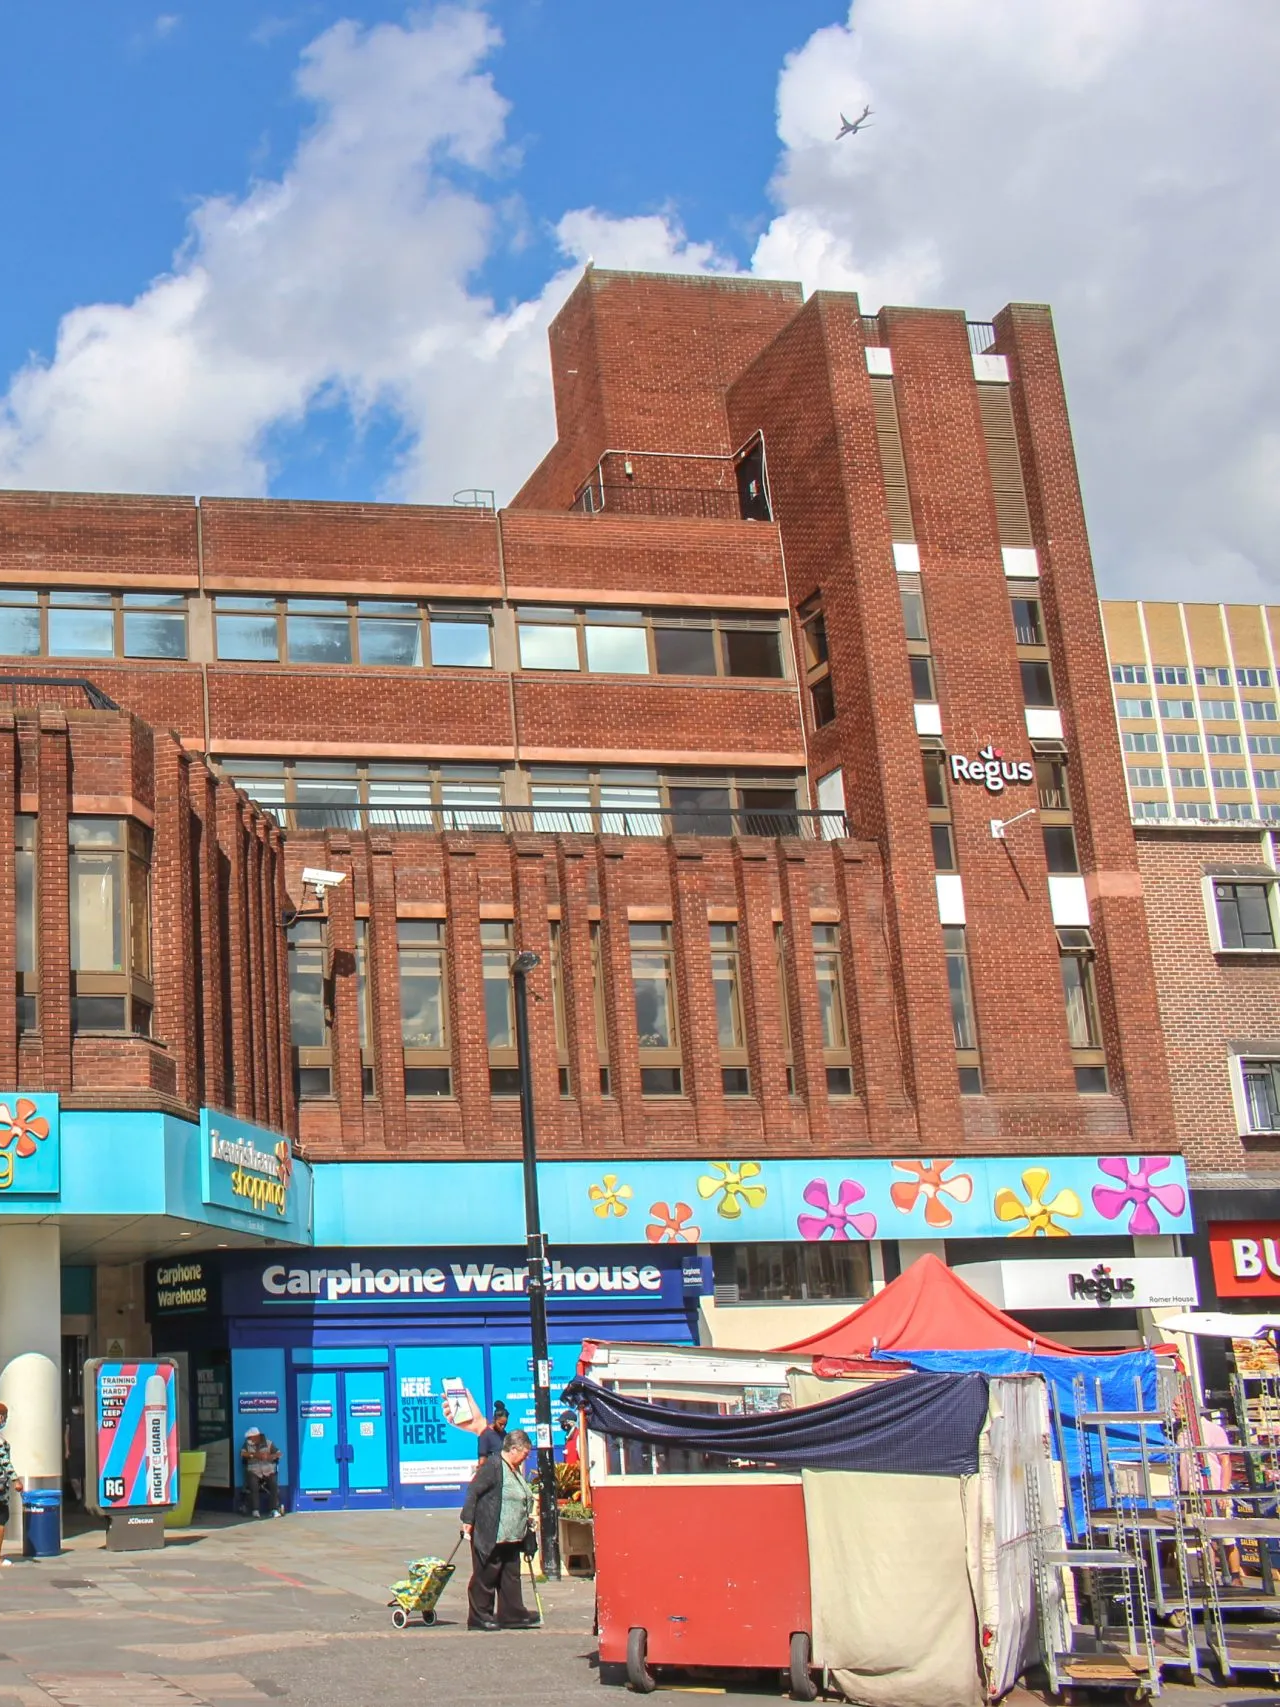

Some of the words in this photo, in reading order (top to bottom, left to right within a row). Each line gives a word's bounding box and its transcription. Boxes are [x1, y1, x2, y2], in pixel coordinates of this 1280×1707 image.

[950, 755, 1033, 790] Regus
[210, 1129, 279, 1177] Lewisham
[231, 1163, 286, 1216] shopping
[157, 1263, 202, 1287] Carphone
[262, 1262, 446, 1300] Carphone
[158, 1287, 207, 1307] Warehouse
[1069, 1273, 1135, 1301] Regus
[102, 1377, 136, 1385] TRAINING
[102, 1387, 126, 1395] HARD?
[402, 1397, 416, 1405] BUT
[103, 1409, 121, 1417] KEEP
[402, 1406, 441, 1423] STILL
[103, 1420, 116, 1428] UP.
[402, 1424, 447, 1445] HERE
[152, 1418, 161, 1455] GUARD
[105, 1479, 125, 1496] RG
[154, 1466, 163, 1499] RIGHT
